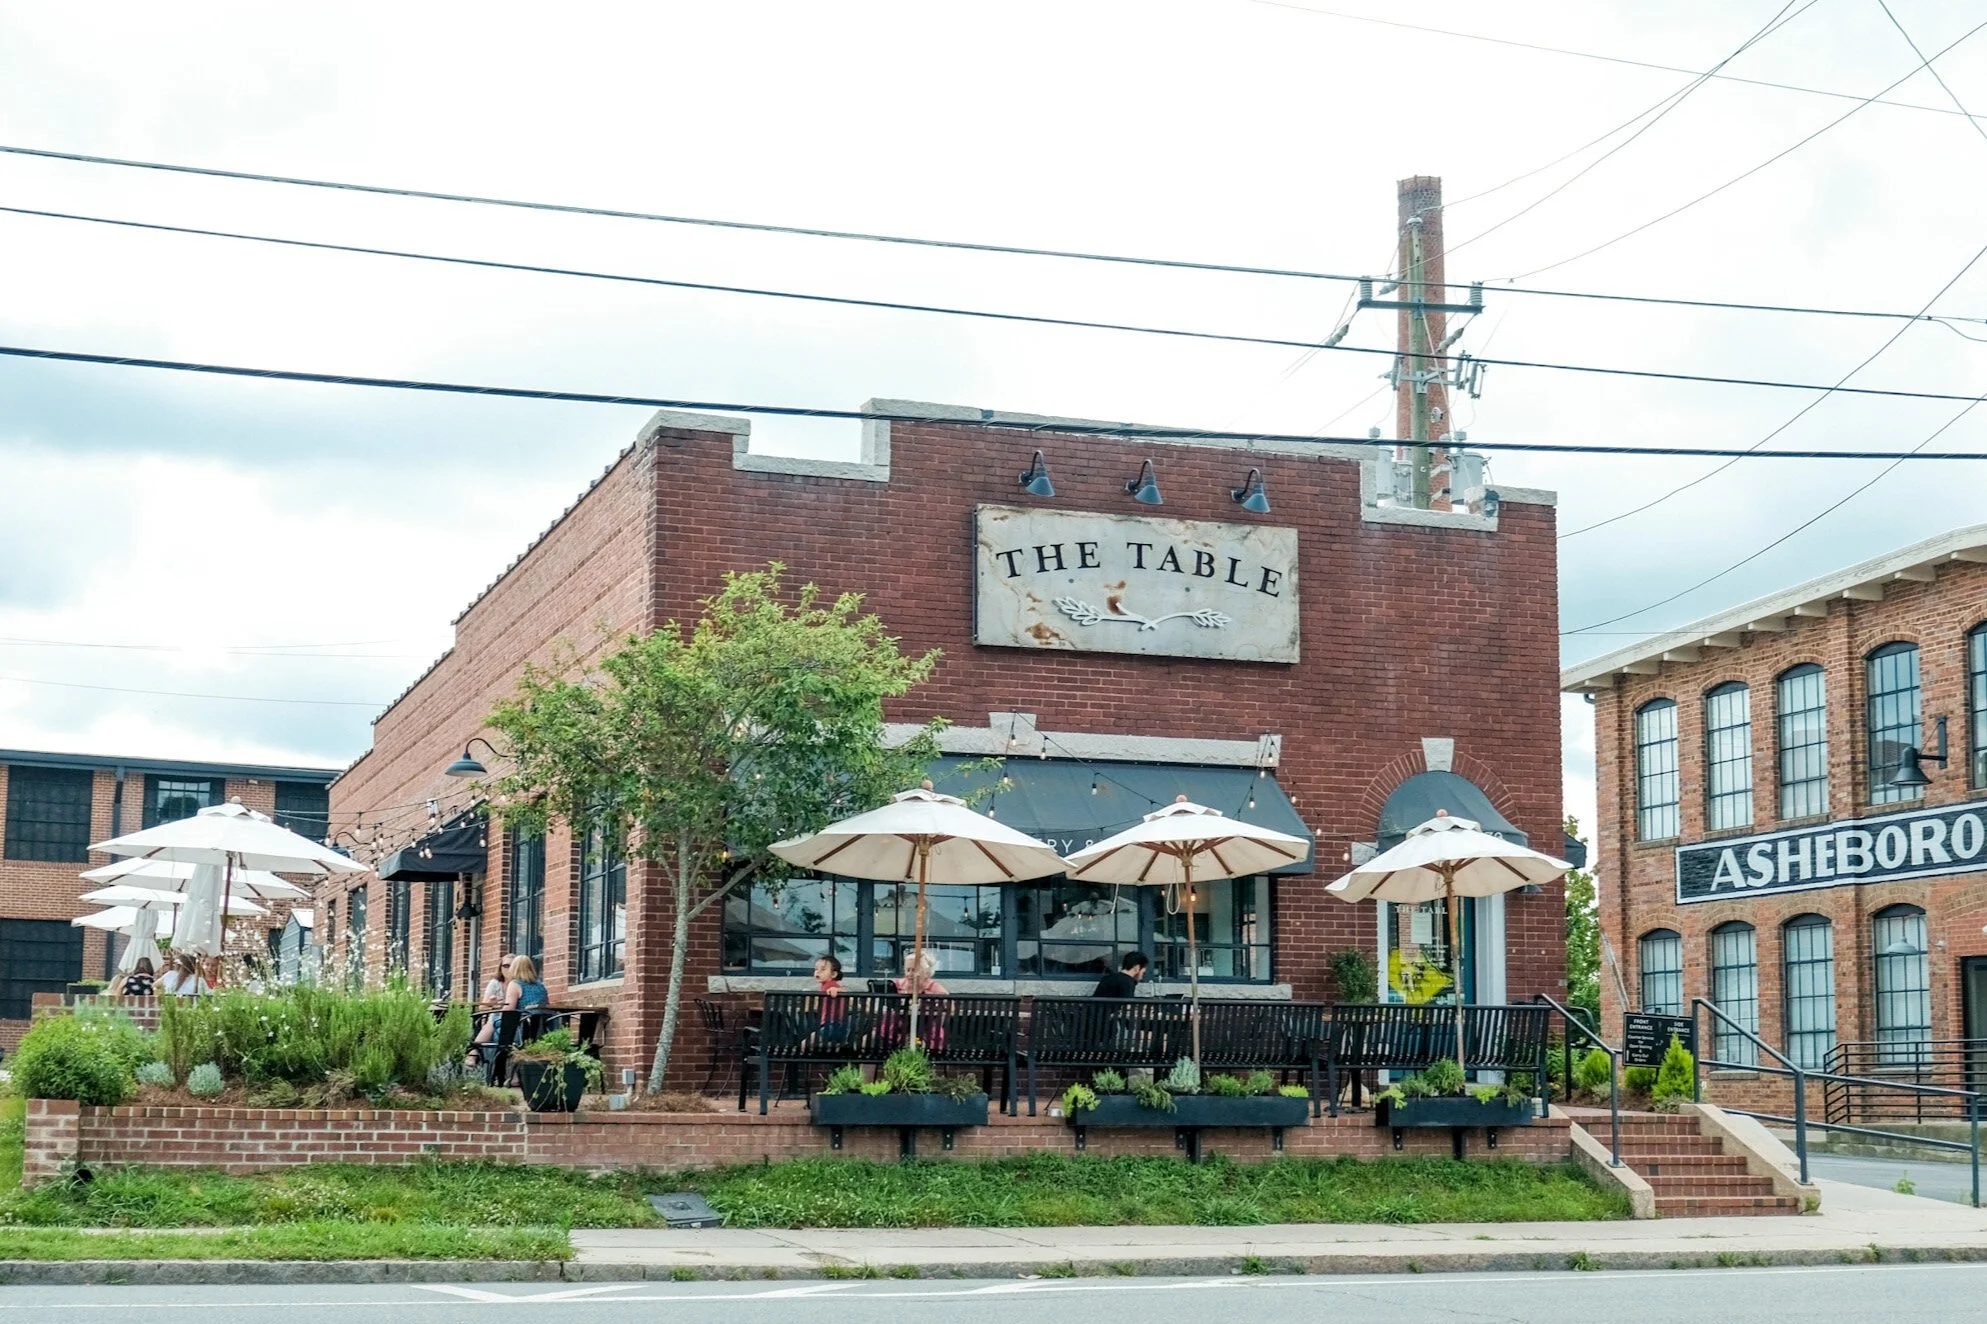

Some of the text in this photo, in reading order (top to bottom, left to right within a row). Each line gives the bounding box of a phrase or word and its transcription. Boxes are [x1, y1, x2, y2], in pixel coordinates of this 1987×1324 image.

[996, 541, 1283, 598] THE TABLE
[1710, 813, 1985, 892] ASHEBORO
[1420, 906, 1448, 915] TABL
